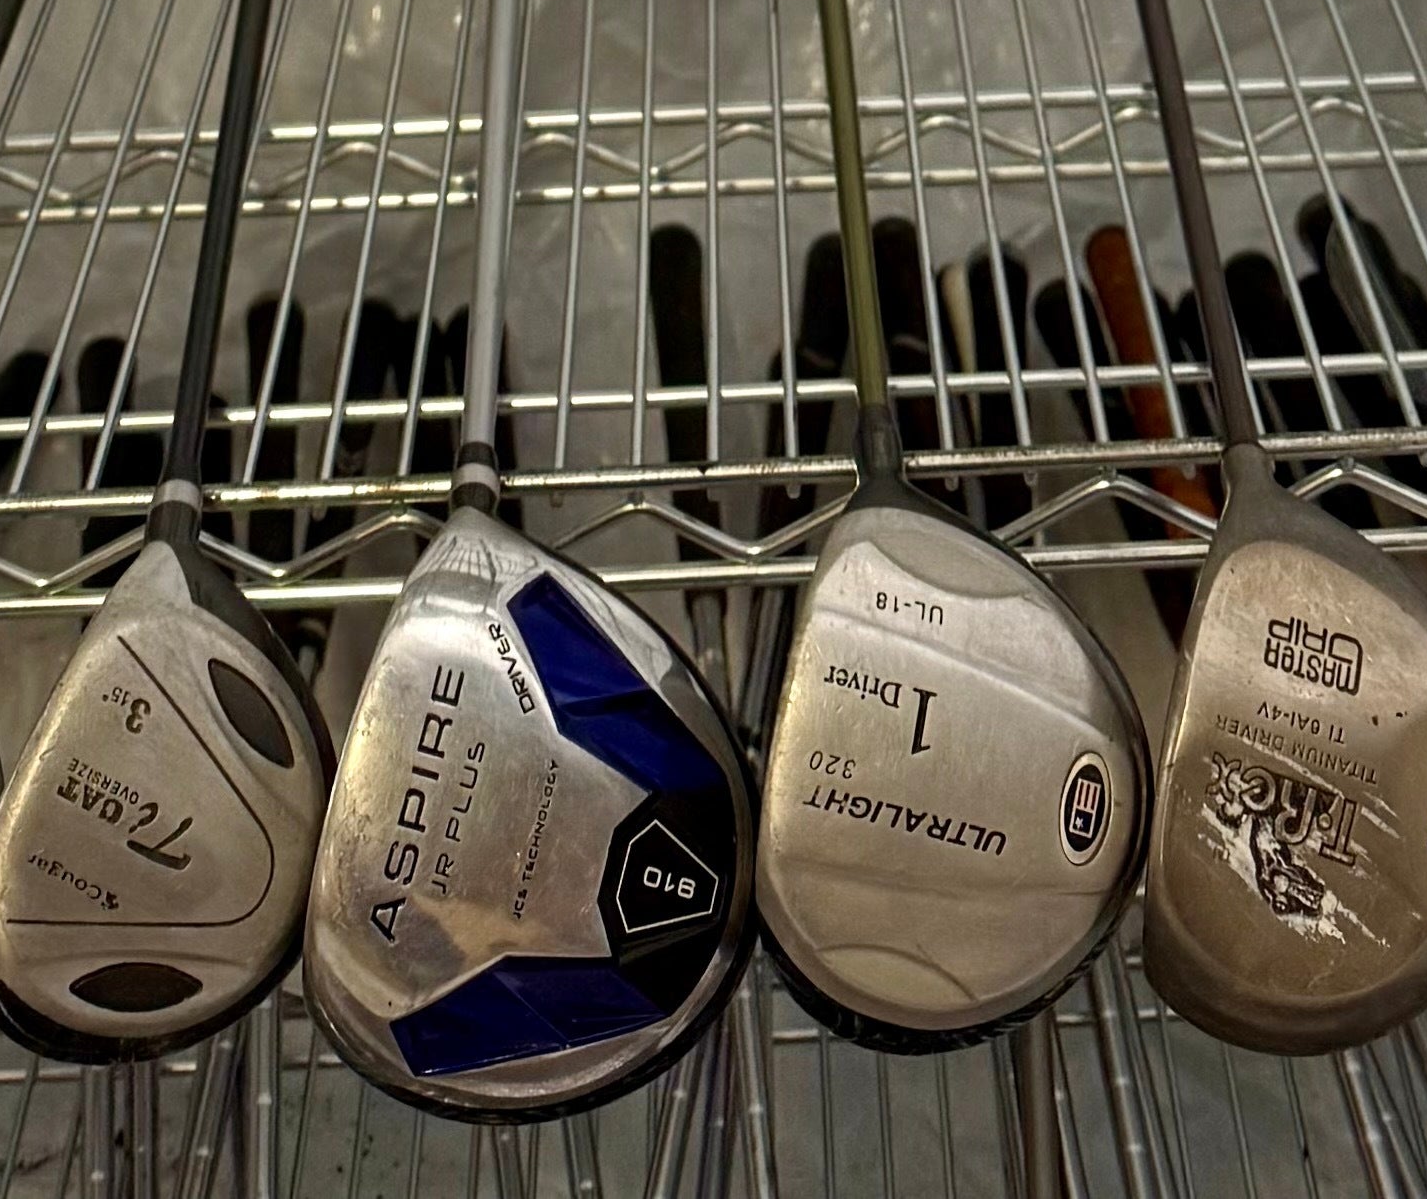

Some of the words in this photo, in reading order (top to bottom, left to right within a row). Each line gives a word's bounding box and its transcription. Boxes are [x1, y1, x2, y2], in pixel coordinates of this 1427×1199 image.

[875, 590, 944, 627] UL-18
[487, 621, 536, 715] DRIVER
[822, 663, 902, 709] Driver
[1263, 637, 1359, 696] MASTER
[124, 698, 151, 734] 3
[909, 685, 938, 757] 1
[1215, 713, 1284, 753] DRIVER
[68, 758, 140, 805] OVERSIZE
[808, 749, 857, 781] 320
[1290, 741, 1378, 785] TITANIUM
[371, 664, 465, 944] ASPIRE
[427, 856, 455, 896] JR
[448, 740, 486, 843] PLUS
[522, 759, 560, 882] TECHNOLOGY
[801, 783, 1009, 857] ULTRALIGHT
[28, 853, 104, 900] Cougar
[642, 864, 697, 900] 810
